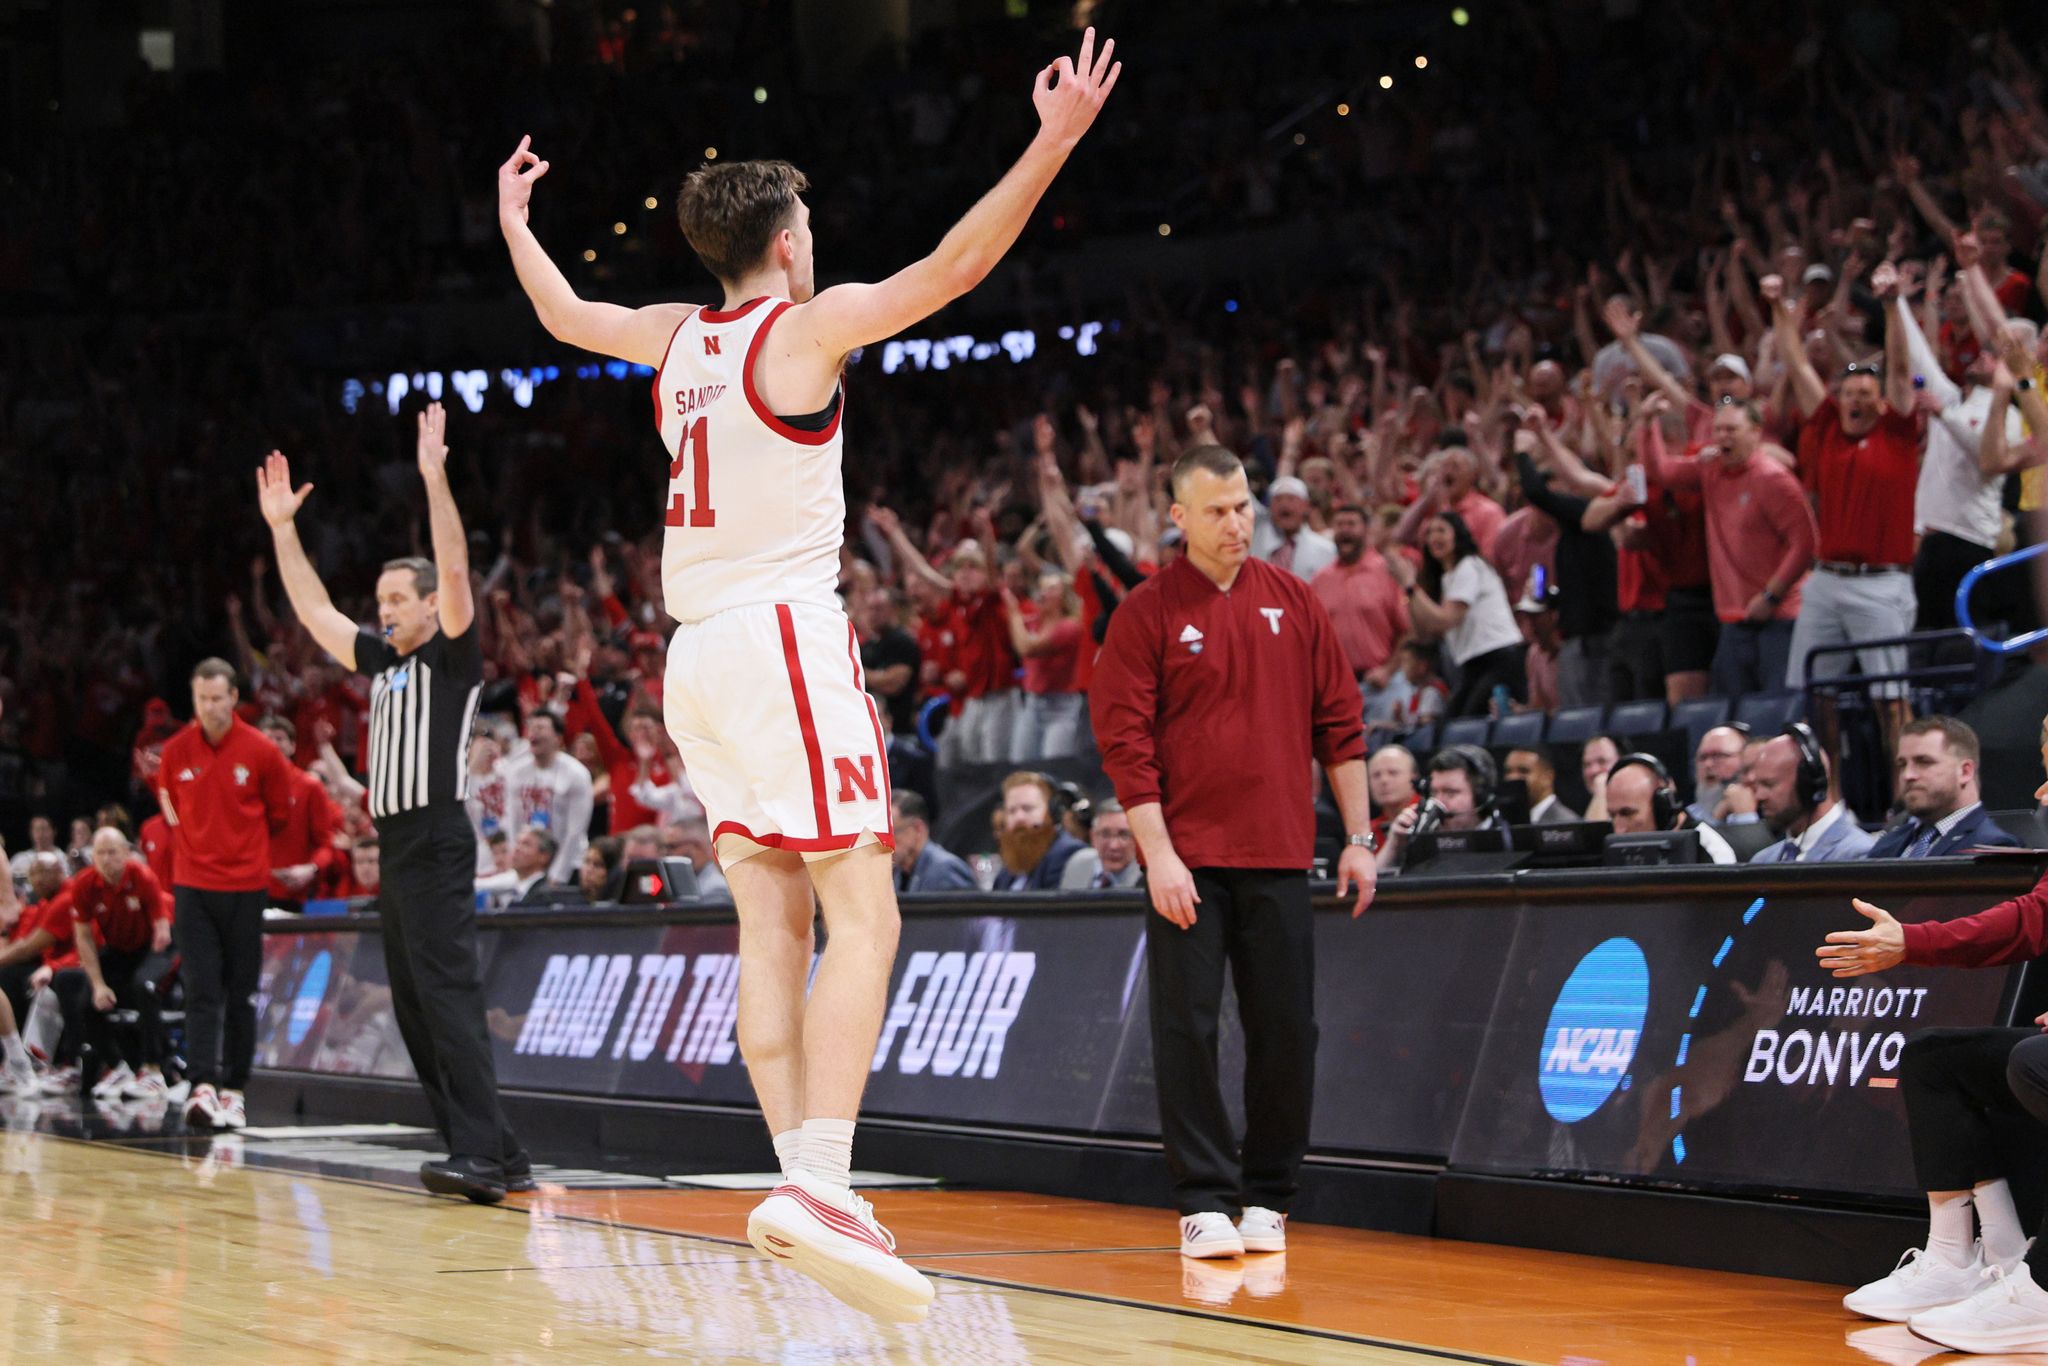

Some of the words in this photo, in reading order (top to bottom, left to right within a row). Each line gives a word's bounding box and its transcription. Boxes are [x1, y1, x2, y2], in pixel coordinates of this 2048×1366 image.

[703, 335, 721, 356] N
[664, 416, 716, 528] 21
[1259, 607, 1285, 636] T
[832, 754, 879, 803] N
[513, 953, 633, 1059] ROAD
[610, 953, 687, 1062] TO
[870, 951, 1037, 1080] FOUR
[1785, 986, 1929, 1019] MARRIOTT
[1543, 1027, 1638, 1076] NCAA
